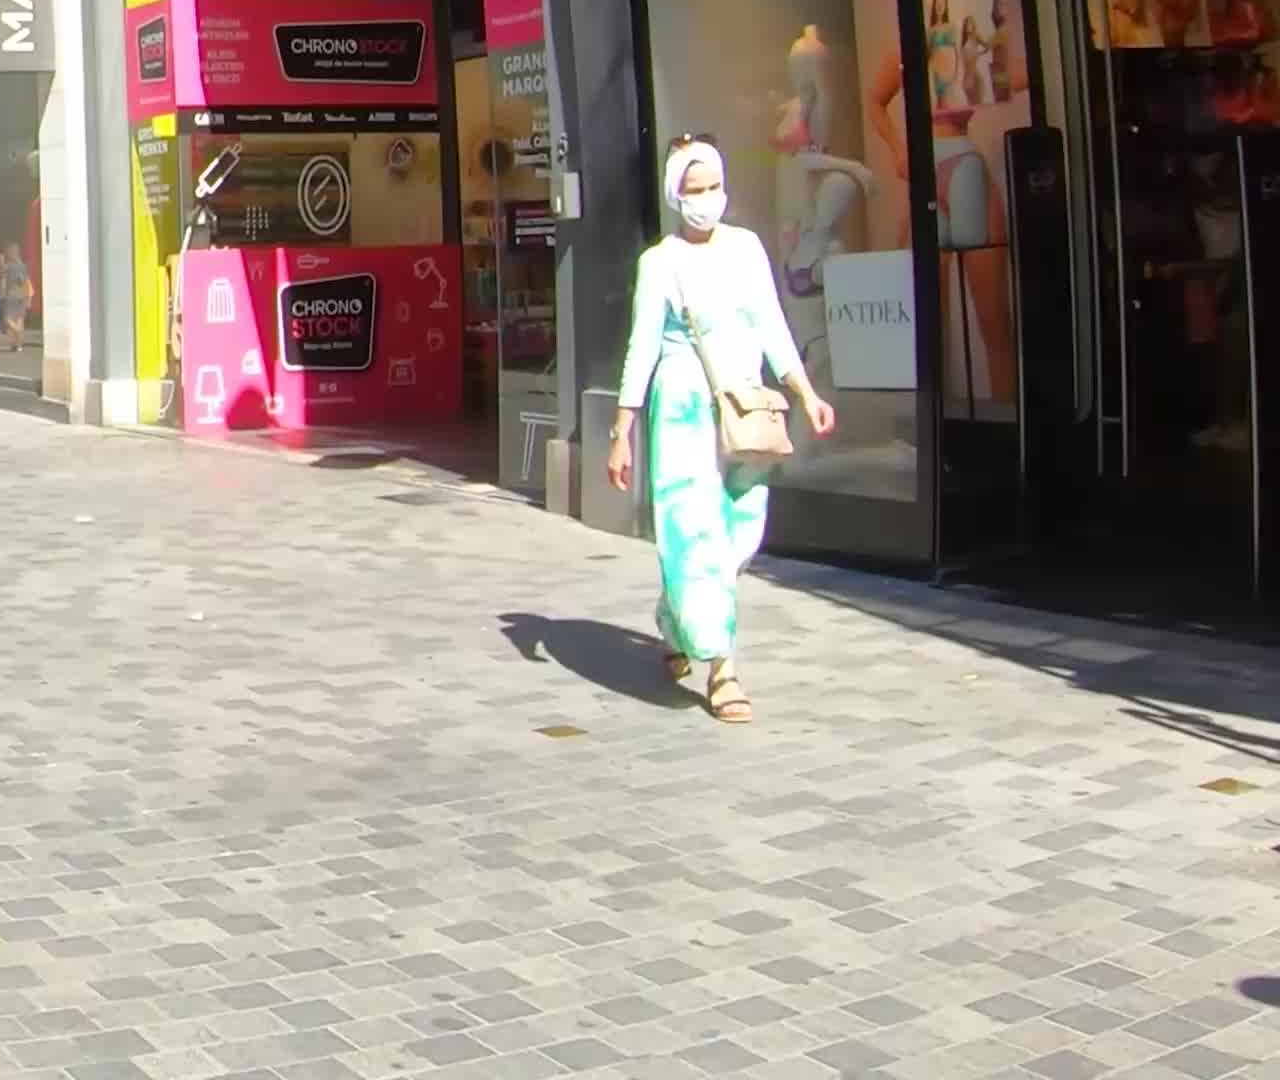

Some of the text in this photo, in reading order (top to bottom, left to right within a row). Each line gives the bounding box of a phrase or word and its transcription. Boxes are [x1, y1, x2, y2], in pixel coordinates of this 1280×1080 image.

[291, 38, 358, 55] CHRONO
[292, 299, 362, 317] CHRONO
[291, 317, 362, 338] STOCK
